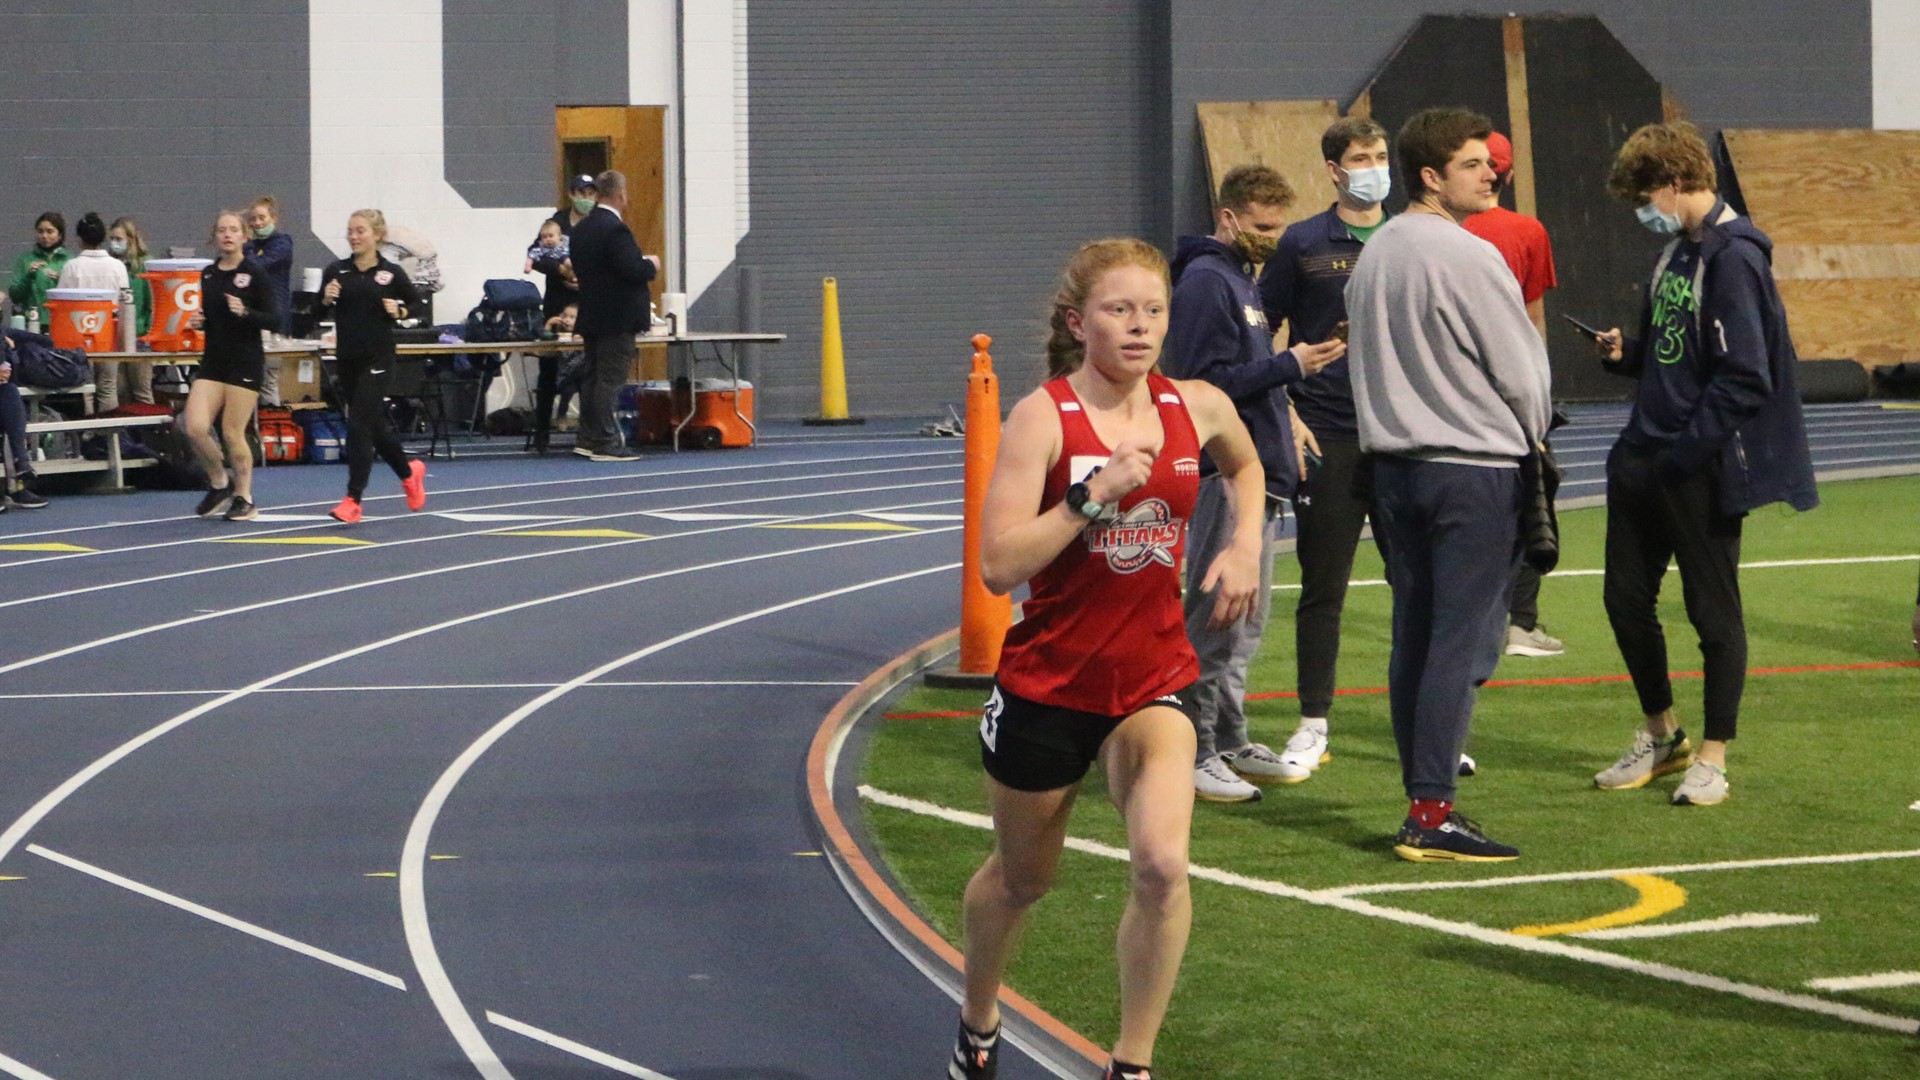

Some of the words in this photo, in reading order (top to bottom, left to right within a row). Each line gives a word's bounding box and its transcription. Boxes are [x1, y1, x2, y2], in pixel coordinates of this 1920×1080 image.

[174, 283, 199, 311] G
[81, 314, 97, 329] G
[1087, 521, 1181, 548] TITANS
